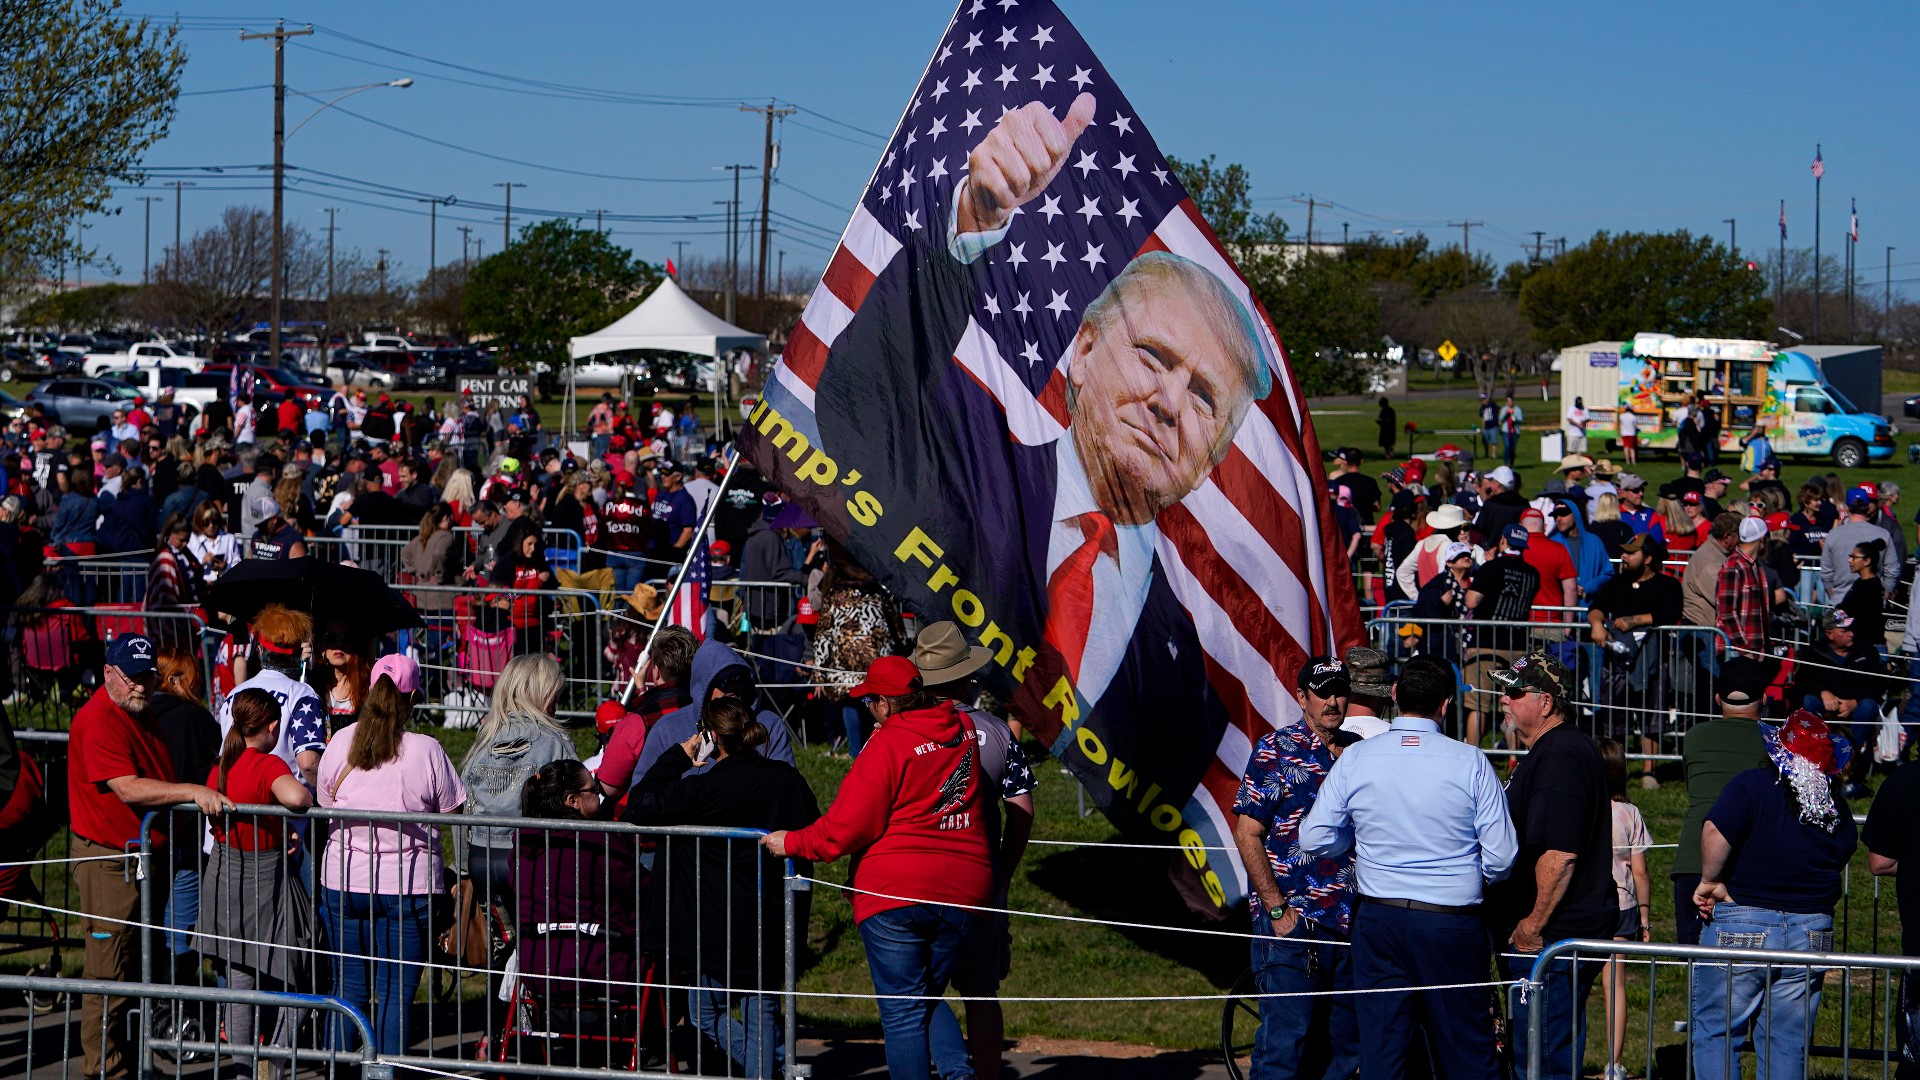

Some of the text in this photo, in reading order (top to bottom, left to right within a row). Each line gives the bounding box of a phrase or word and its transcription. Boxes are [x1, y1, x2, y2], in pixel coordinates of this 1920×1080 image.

[461, 379, 528, 393] RENT CAR
[605, 501, 643, 517] Proud
[606, 521, 640, 533] Texan
[254, 541, 281, 553] TRUMP
[893, 526, 1037, 683] Front
[913, 742, 937, 756] WE'RE
